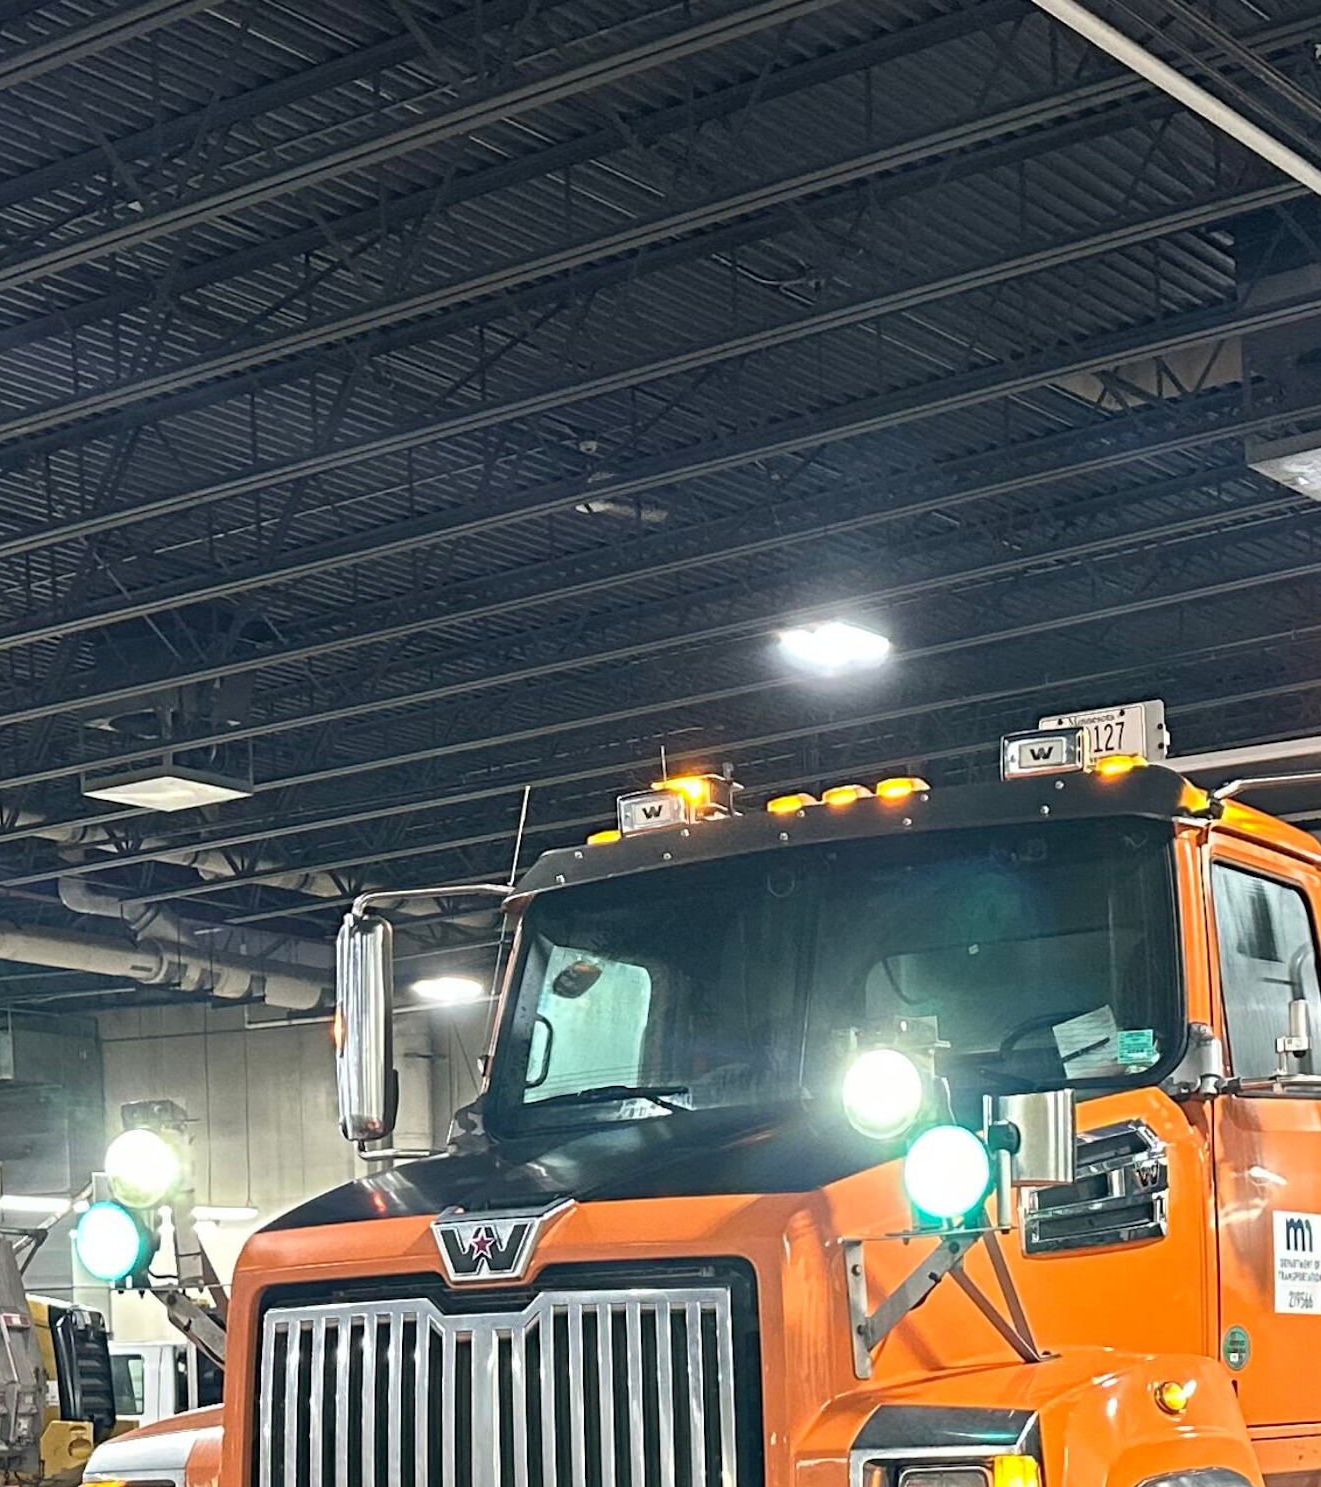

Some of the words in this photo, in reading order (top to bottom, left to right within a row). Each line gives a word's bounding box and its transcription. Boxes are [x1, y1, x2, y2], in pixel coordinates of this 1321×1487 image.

[1093, 721, 1125, 752] 127
[1029, 746, 1054, 761] W
[641, 804, 663, 819] W
[440, 1223, 530, 1275] W
